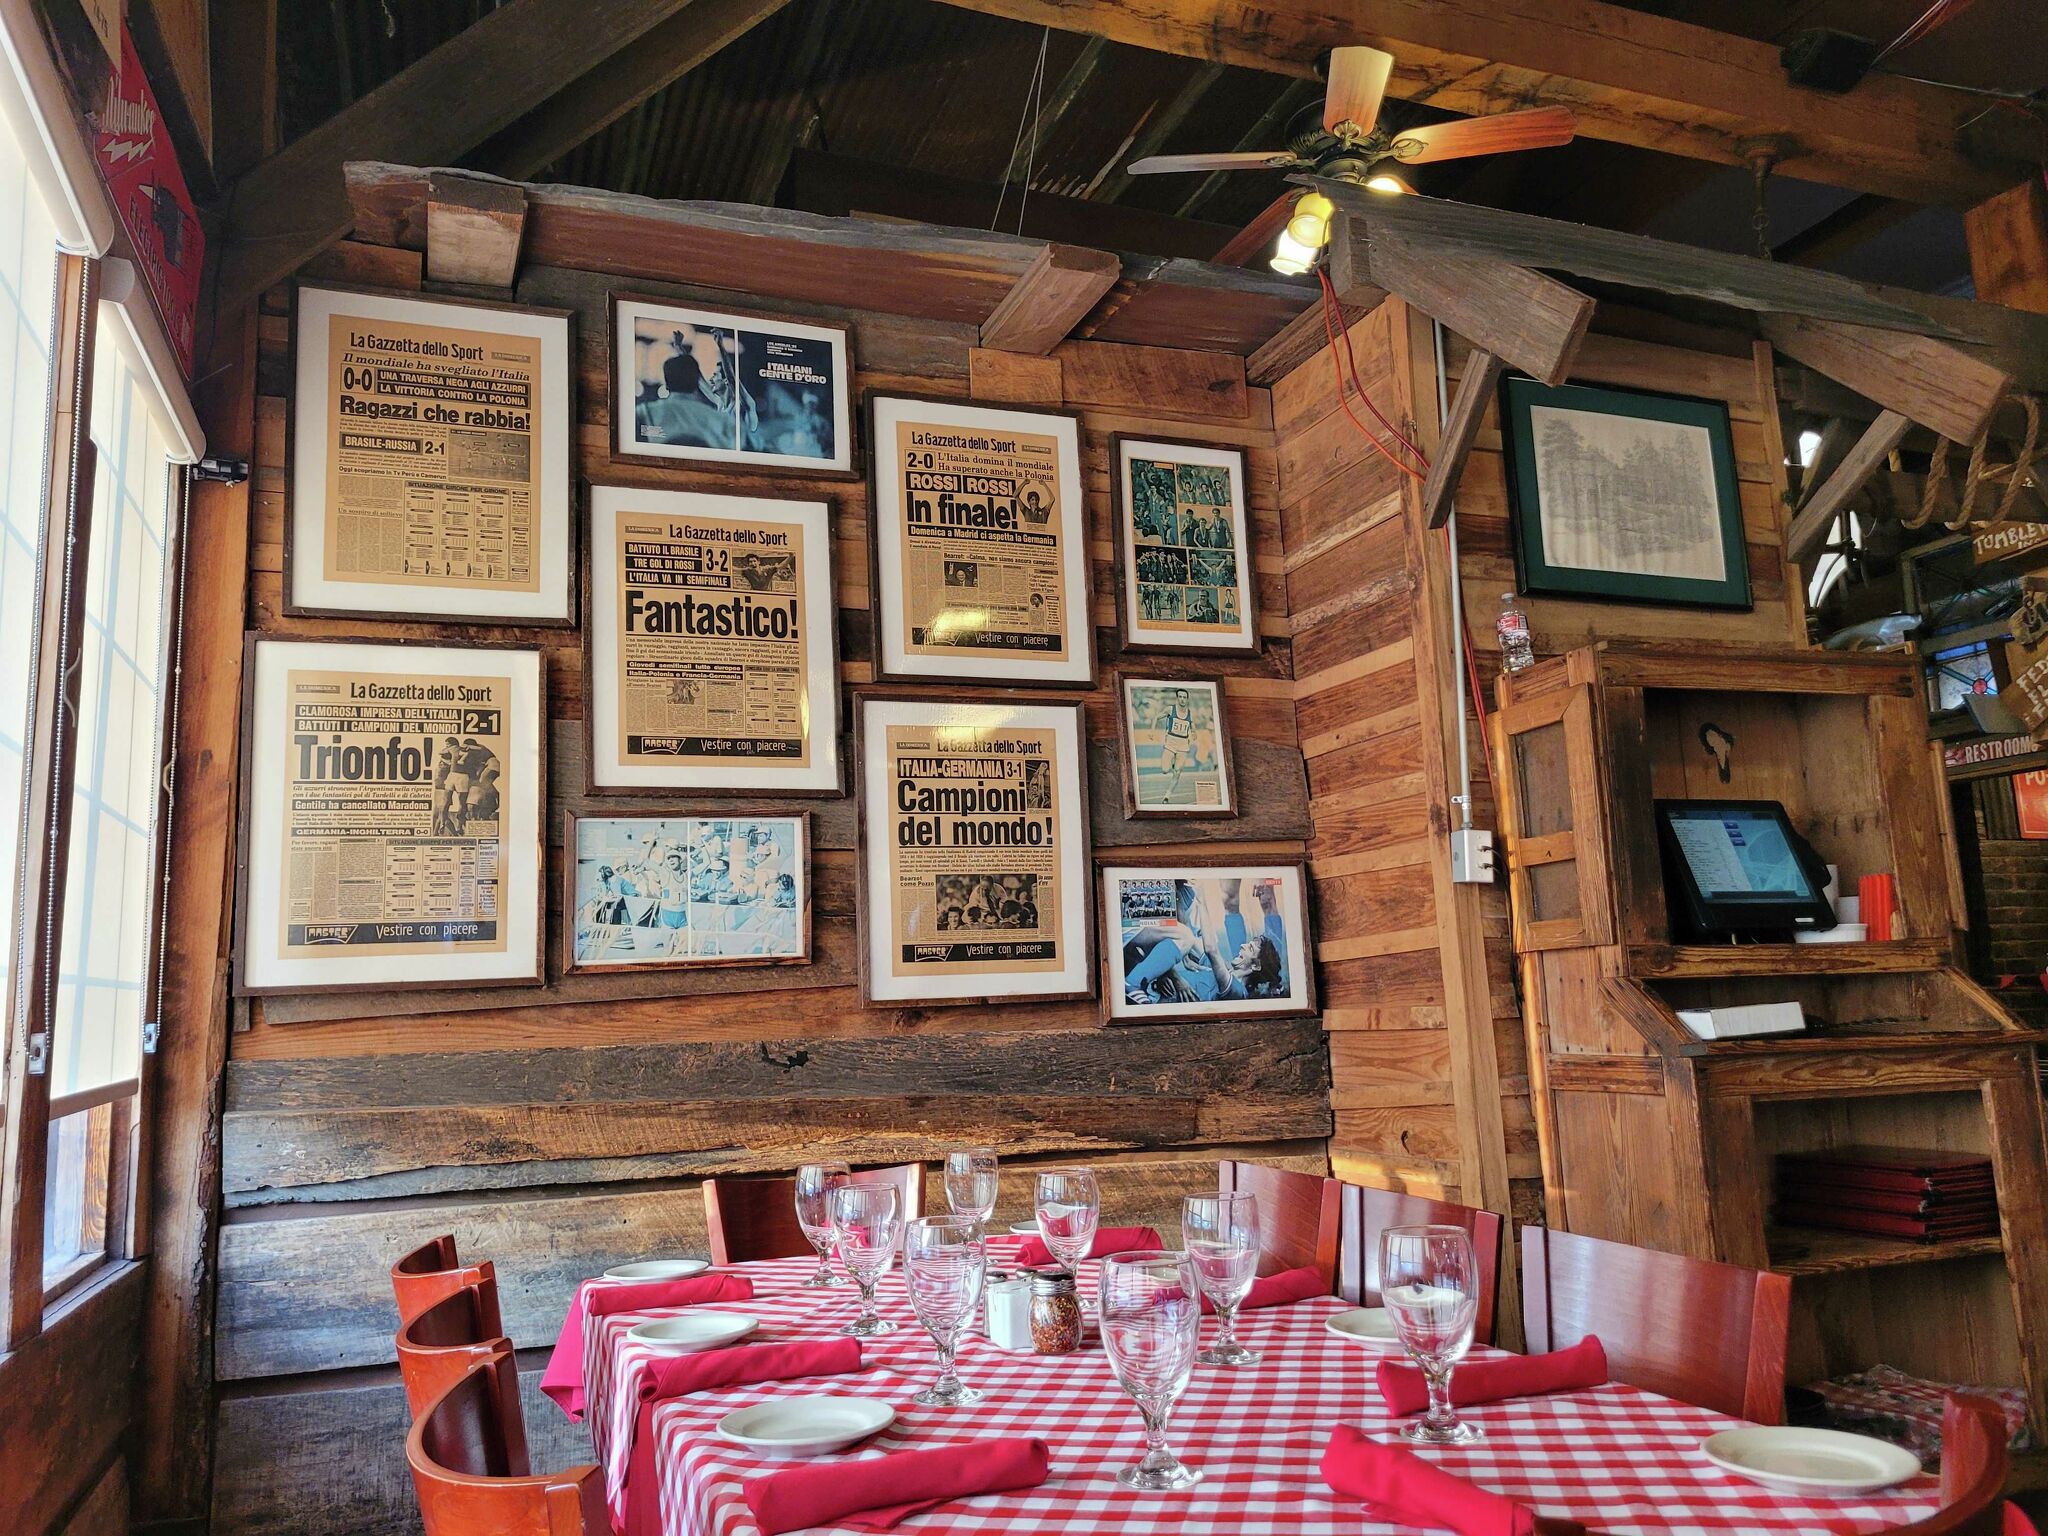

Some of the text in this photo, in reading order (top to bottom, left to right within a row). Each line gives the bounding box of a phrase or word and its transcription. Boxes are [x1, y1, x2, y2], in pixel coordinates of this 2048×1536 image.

[350, 332, 365, 348] La
[367, 334, 420, 354] Gazzetta
[422, 340, 448, 357] dello
[451, 343, 484, 361] Sport
[343, 352, 353, 362] Il
[355, 356, 413, 369] mondiale
[416, 360, 432, 372] ha
[433, 364, 489, 377] svegliato
[767, 362, 812, 374] ITALIANI
[343, 366, 373, 392] 0-0
[380, 371, 398, 381] UNA
[400, 373, 444, 386] TRAVERSA
[470, 380, 489, 390] AGLI
[490, 382, 526, 394] AZZURRI
[759, 369, 827, 384] GENTE D'ORO
[380, 383, 526, 406] LA VITTORIA CONTRO LA POLONIA
[340, 394, 418, 419] Ragazzi
[423, 403, 459, 423] che
[464, 408, 531, 430] rabbia!
[345, 436, 445, 455] BRASILE-RUSSIA 2-1
[912, 431, 923, 445] La
[925, 432, 967, 448] Gazzetta
[968, 436, 989, 450] dello
[990, 438, 1016, 453] Sport
[907, 452, 934, 469] 2-0
[938, 452, 1054, 471] L'Italia domina il mondiale
[938, 462, 1054, 480] Ha superato anche la Polonia
[910, 473, 1013, 496] ROSSI ROSSI
[907, 491, 1018, 530] In finale!
[669, 524, 683, 539] La
[684, 525, 731, 541] Gazzetta
[733, 529, 757, 544] dello
[759, 530, 787, 546] Sport
[910, 526, 1054, 545] Domenica a Madrid ci aspetta la Germania
[628, 543, 699, 557] BATTUTO IL BRASILE
[633, 558, 695, 570] TRE GOL DI ROSSI
[705, 548, 729, 572] 3-2
[629, 572, 728, 587] L'ITALIA VA IN SEMIFINALE
[625, 589, 798, 639] Fantastico!
[975, 633, 1002, 646] Vestire
[1006, 634, 1019, 645] con
[1023, 635, 1049, 647] piacere
[351, 682, 366, 699] La
[368, 682, 425, 700] Gazzetta
[427, 685, 455, 701] dello
[457, 685, 492, 703] Sport
[299, 705, 459, 720] CLAMOROSA IMPRESA DELL'ITALIA
[298, 720, 458, 734] BATTUTI I CAMPIONI DEL MONDO
[465, 712, 498, 733] 2-1
[701, 739, 731, 752] Vestire
[736, 740, 751, 751] con
[756, 740, 786, 752] piacere
[994, 740, 1015, 754] dello
[1016, 740, 1042, 755] Sport
[294, 735, 433, 780] Trionfo!
[900, 759, 1022, 778] ITALIA-GERMANIA 3-1
[295, 800, 429, 810] Gentile ha cancellato Maradona
[897, 779, 1026, 816] Campioni
[899, 816, 1053, 846] del mondo!
[376, 924, 412, 939] Vestire
[419, 926, 436, 936] con
[443, 924, 478, 938] piacere
[966, 944, 994, 957] Vestire
[998, 945, 1012, 955] con
[1016, 944, 1042, 957] piacere
